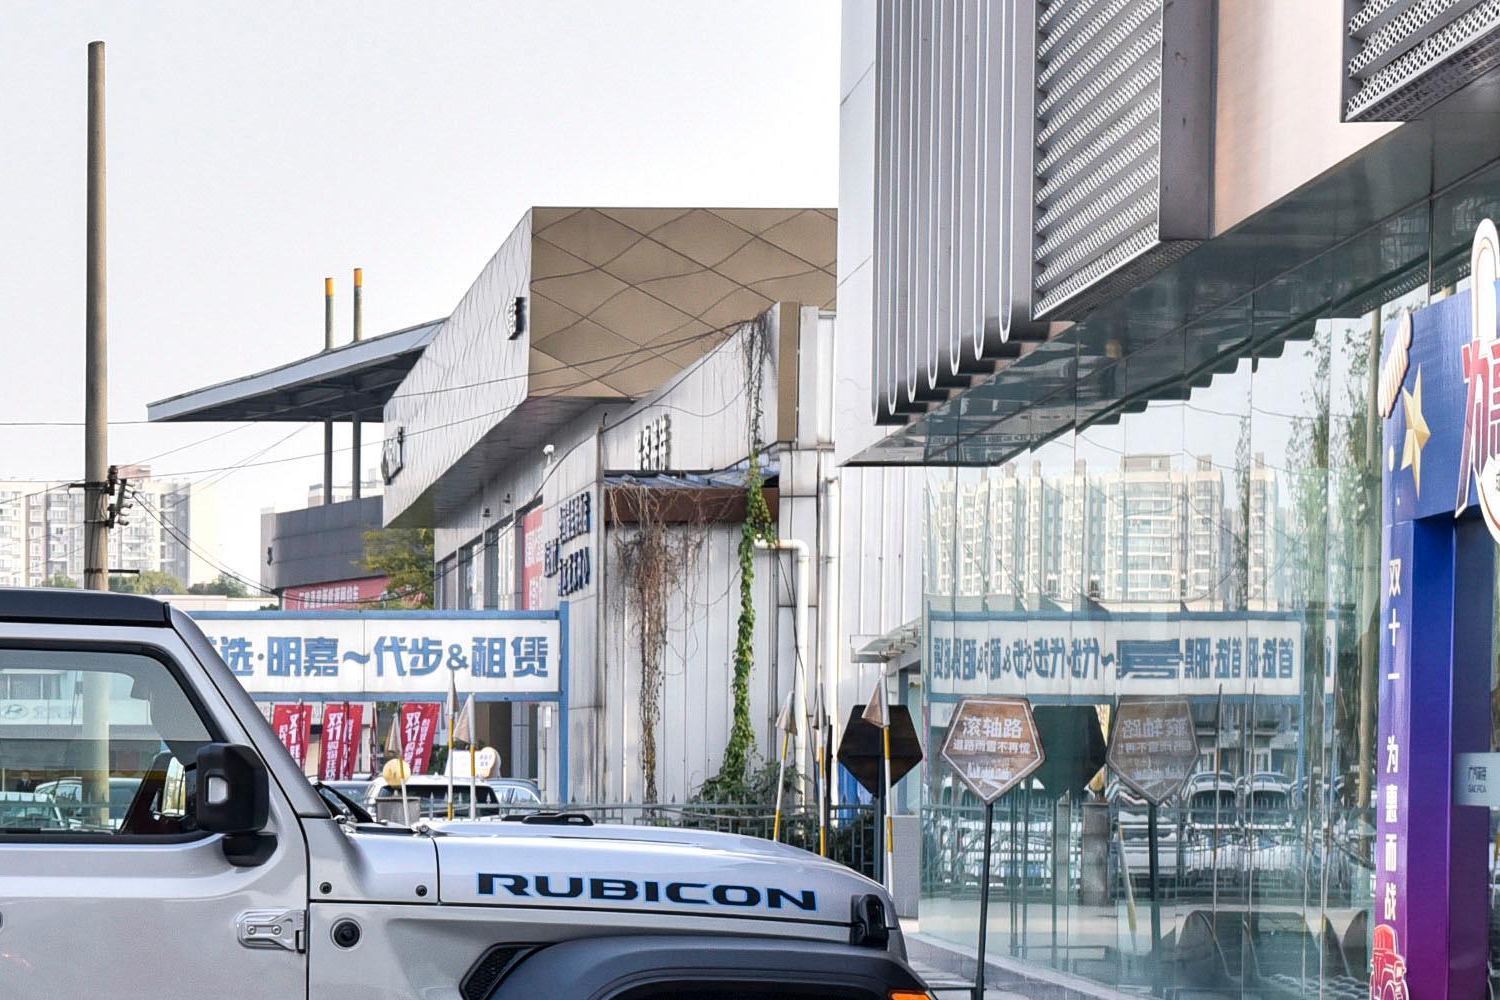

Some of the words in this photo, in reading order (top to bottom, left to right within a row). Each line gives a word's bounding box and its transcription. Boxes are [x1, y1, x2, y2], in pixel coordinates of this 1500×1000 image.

[199, 635, 549, 679] 选·明嘉~代步&租赁
[1383, 736, 1399, 921] 为惠而战
[477, 872, 818, 912] RUBICON
